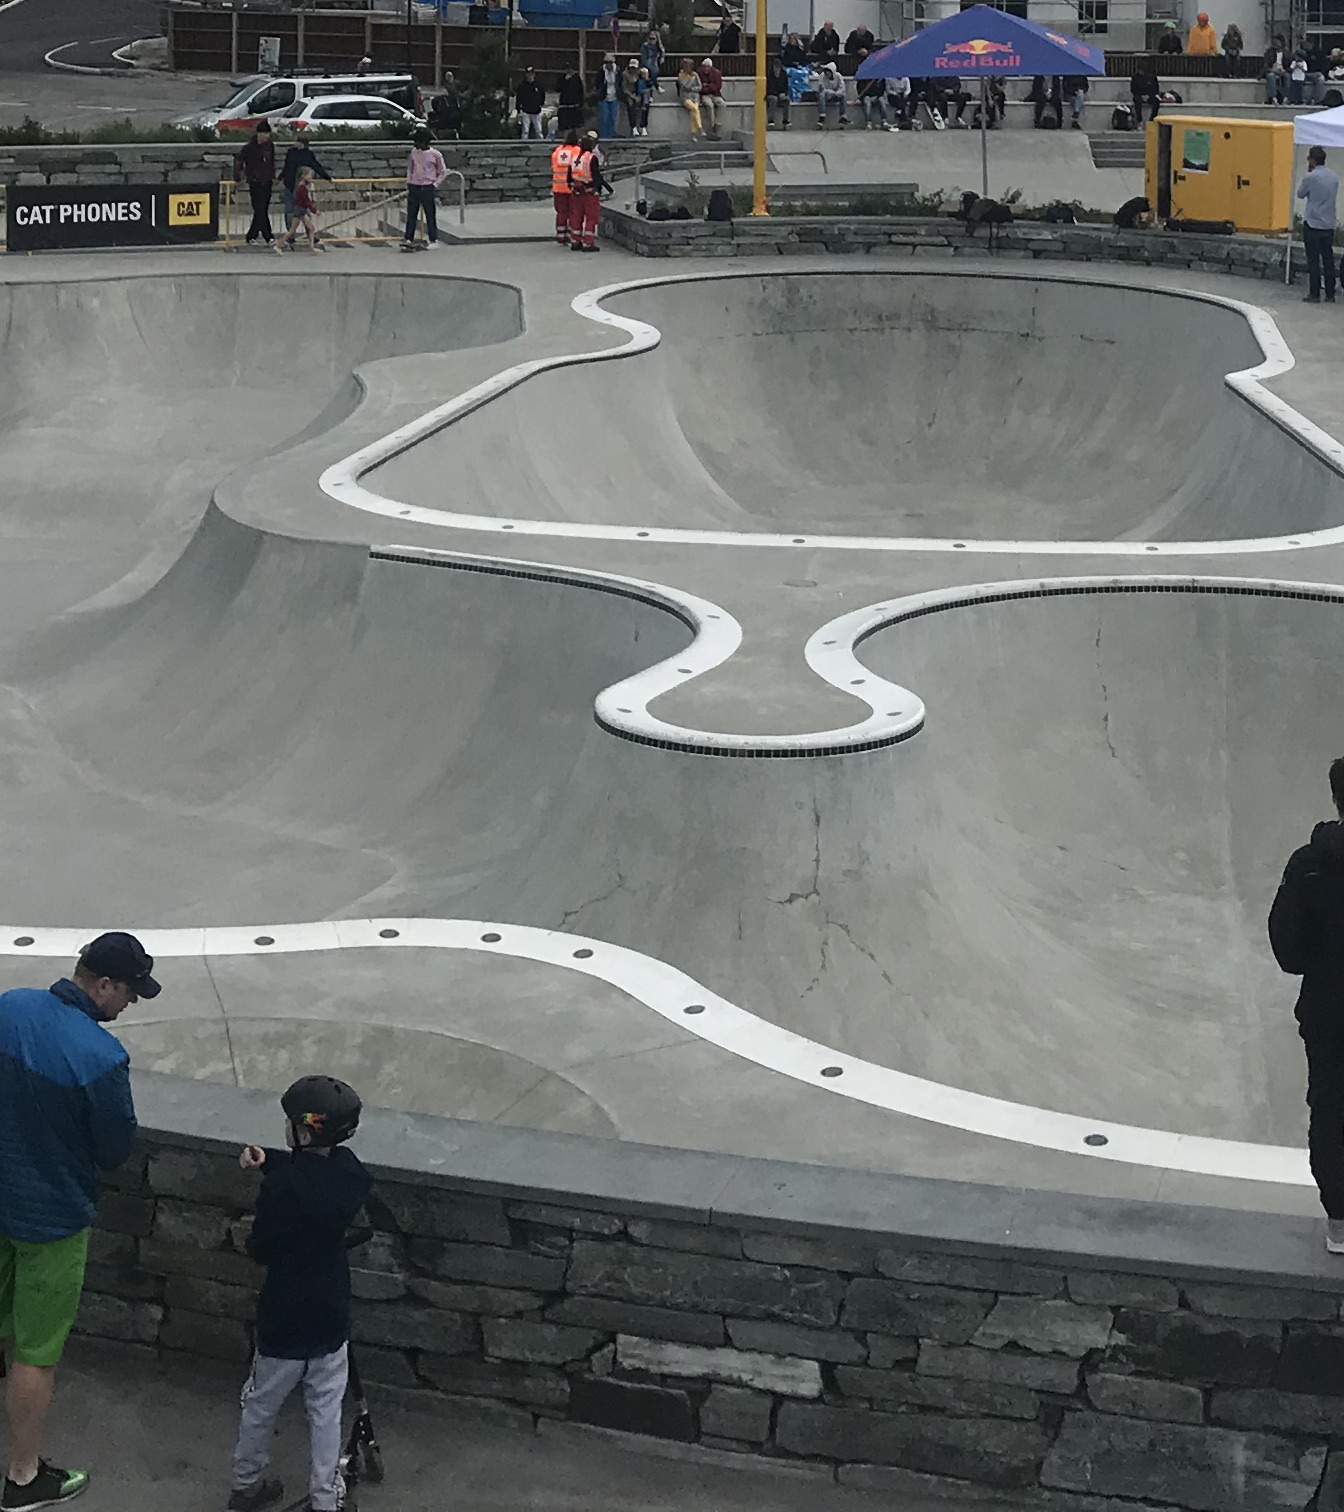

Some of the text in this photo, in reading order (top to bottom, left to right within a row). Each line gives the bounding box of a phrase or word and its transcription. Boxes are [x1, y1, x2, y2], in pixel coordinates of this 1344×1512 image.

[935, 55, 1021, 68] Red Bull
[16, 202, 142, 225] CAT PHONES
[177, 201, 202, 217] CAT
